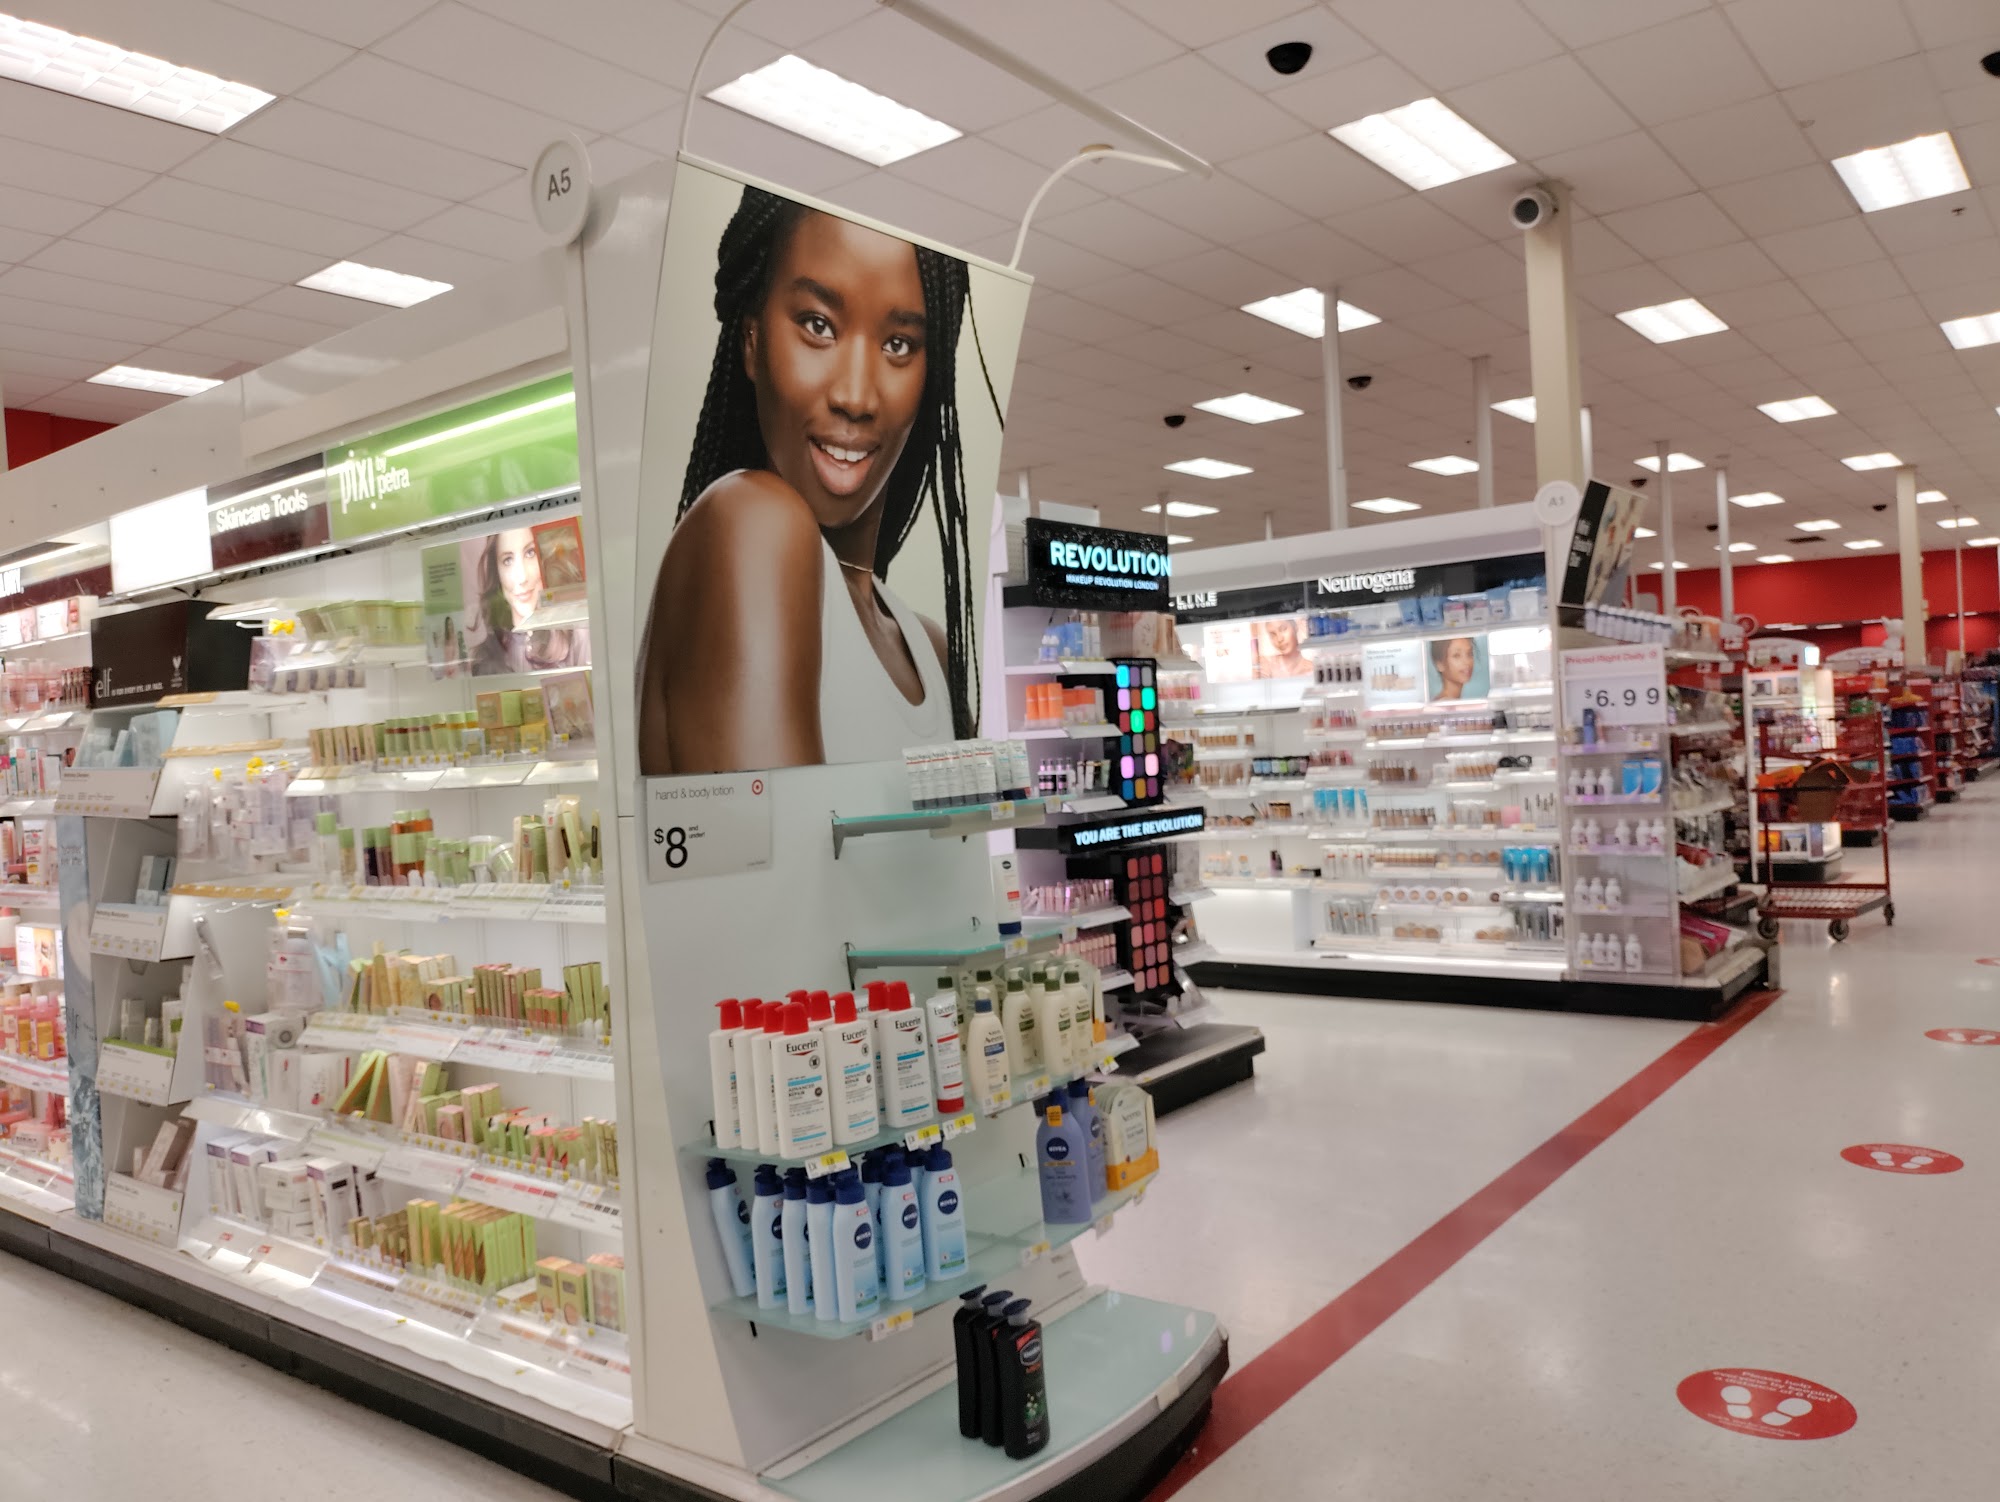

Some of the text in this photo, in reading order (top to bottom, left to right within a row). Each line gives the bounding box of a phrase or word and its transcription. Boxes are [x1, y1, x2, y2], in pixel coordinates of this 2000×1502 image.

[548, 167, 571, 201] A5
[377, 466, 410, 500] petra
[216, 488, 308, 532] Skincare Tools
[1050, 540, 1172, 576] REVOLUTION
[1066, 574, 1159, 591] MAKEUP REVOLUTION LONDON
[1318, 569, 1416, 594] Neutrogena
[1168, 591, 1218, 606] LINE
[95, 668, 112, 698] elf
[656, 786, 734, 800] hand & body lotion
[1074, 814, 1203, 846] YOU ARE THE REVOLUTION
[654, 826, 688, 868] $8
[934, 1004, 956, 1016] Eucerin
[896, 1016, 922, 1030] Eucerin
[842, 1028, 868, 1042] Eucerin
[786, 1040, 819, 1052] Eucerin
[939, 1197, 958, 1207] NIVEA
[904, 1212, 918, 1222] NIVEA
[856, 1231, 872, 1242] NIVEA
[1742, 1372, 1812, 1390] Please help
[1725, 1378, 1777, 1391] distance
[1807, 1394, 1832, 1403] feet
[1788, 1385, 1838, 1400] keeping
